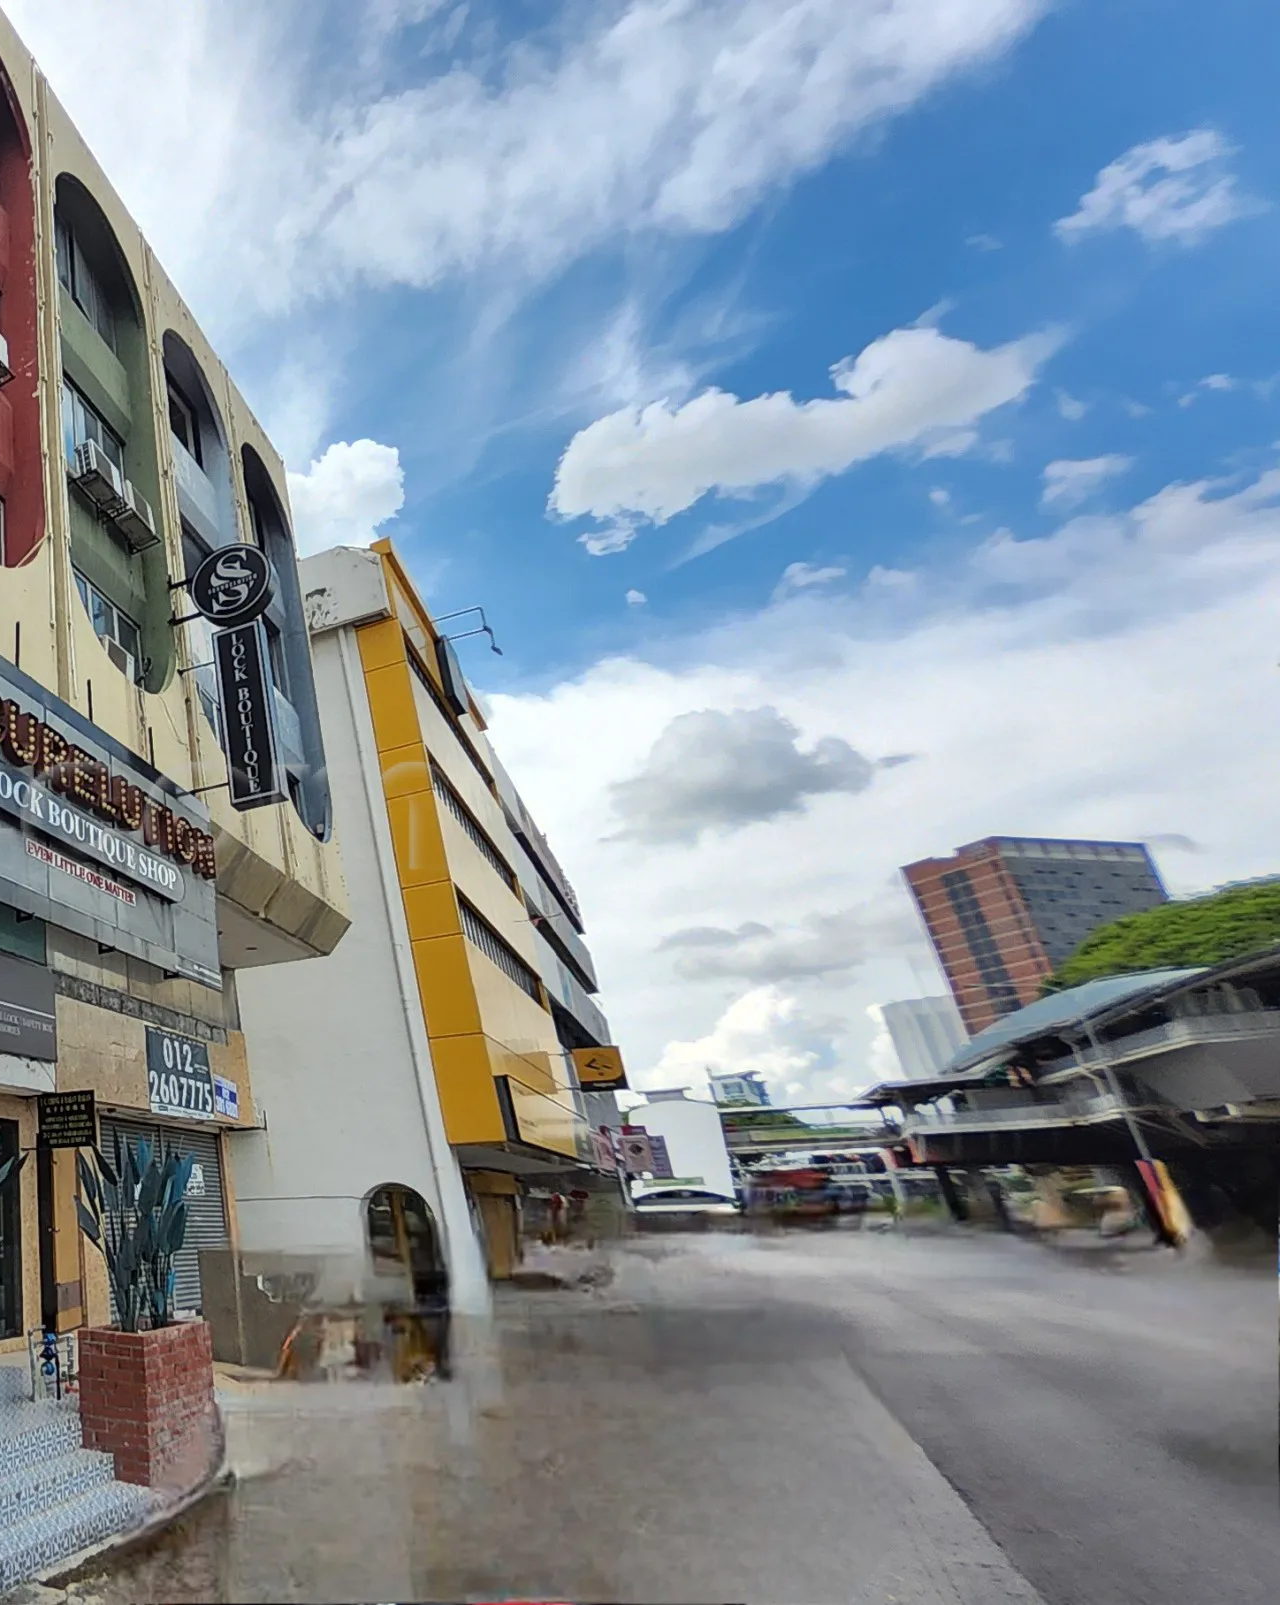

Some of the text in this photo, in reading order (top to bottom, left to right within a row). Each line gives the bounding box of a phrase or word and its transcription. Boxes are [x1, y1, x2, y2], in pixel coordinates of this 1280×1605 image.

[231, 632, 261, 794] LOCK BOUTIQUE
[27, 840, 53, 864] EVEN
[55, 854, 86, 880] LITTLE
[86, 871, 104, 889] ONE
[48, 798, 137, 870] BOUTIQUE
[139, 852, 177, 890] SHOP
[163, 1037, 194, 1074] 012
[149, 1070, 213, 1113] 2607775
